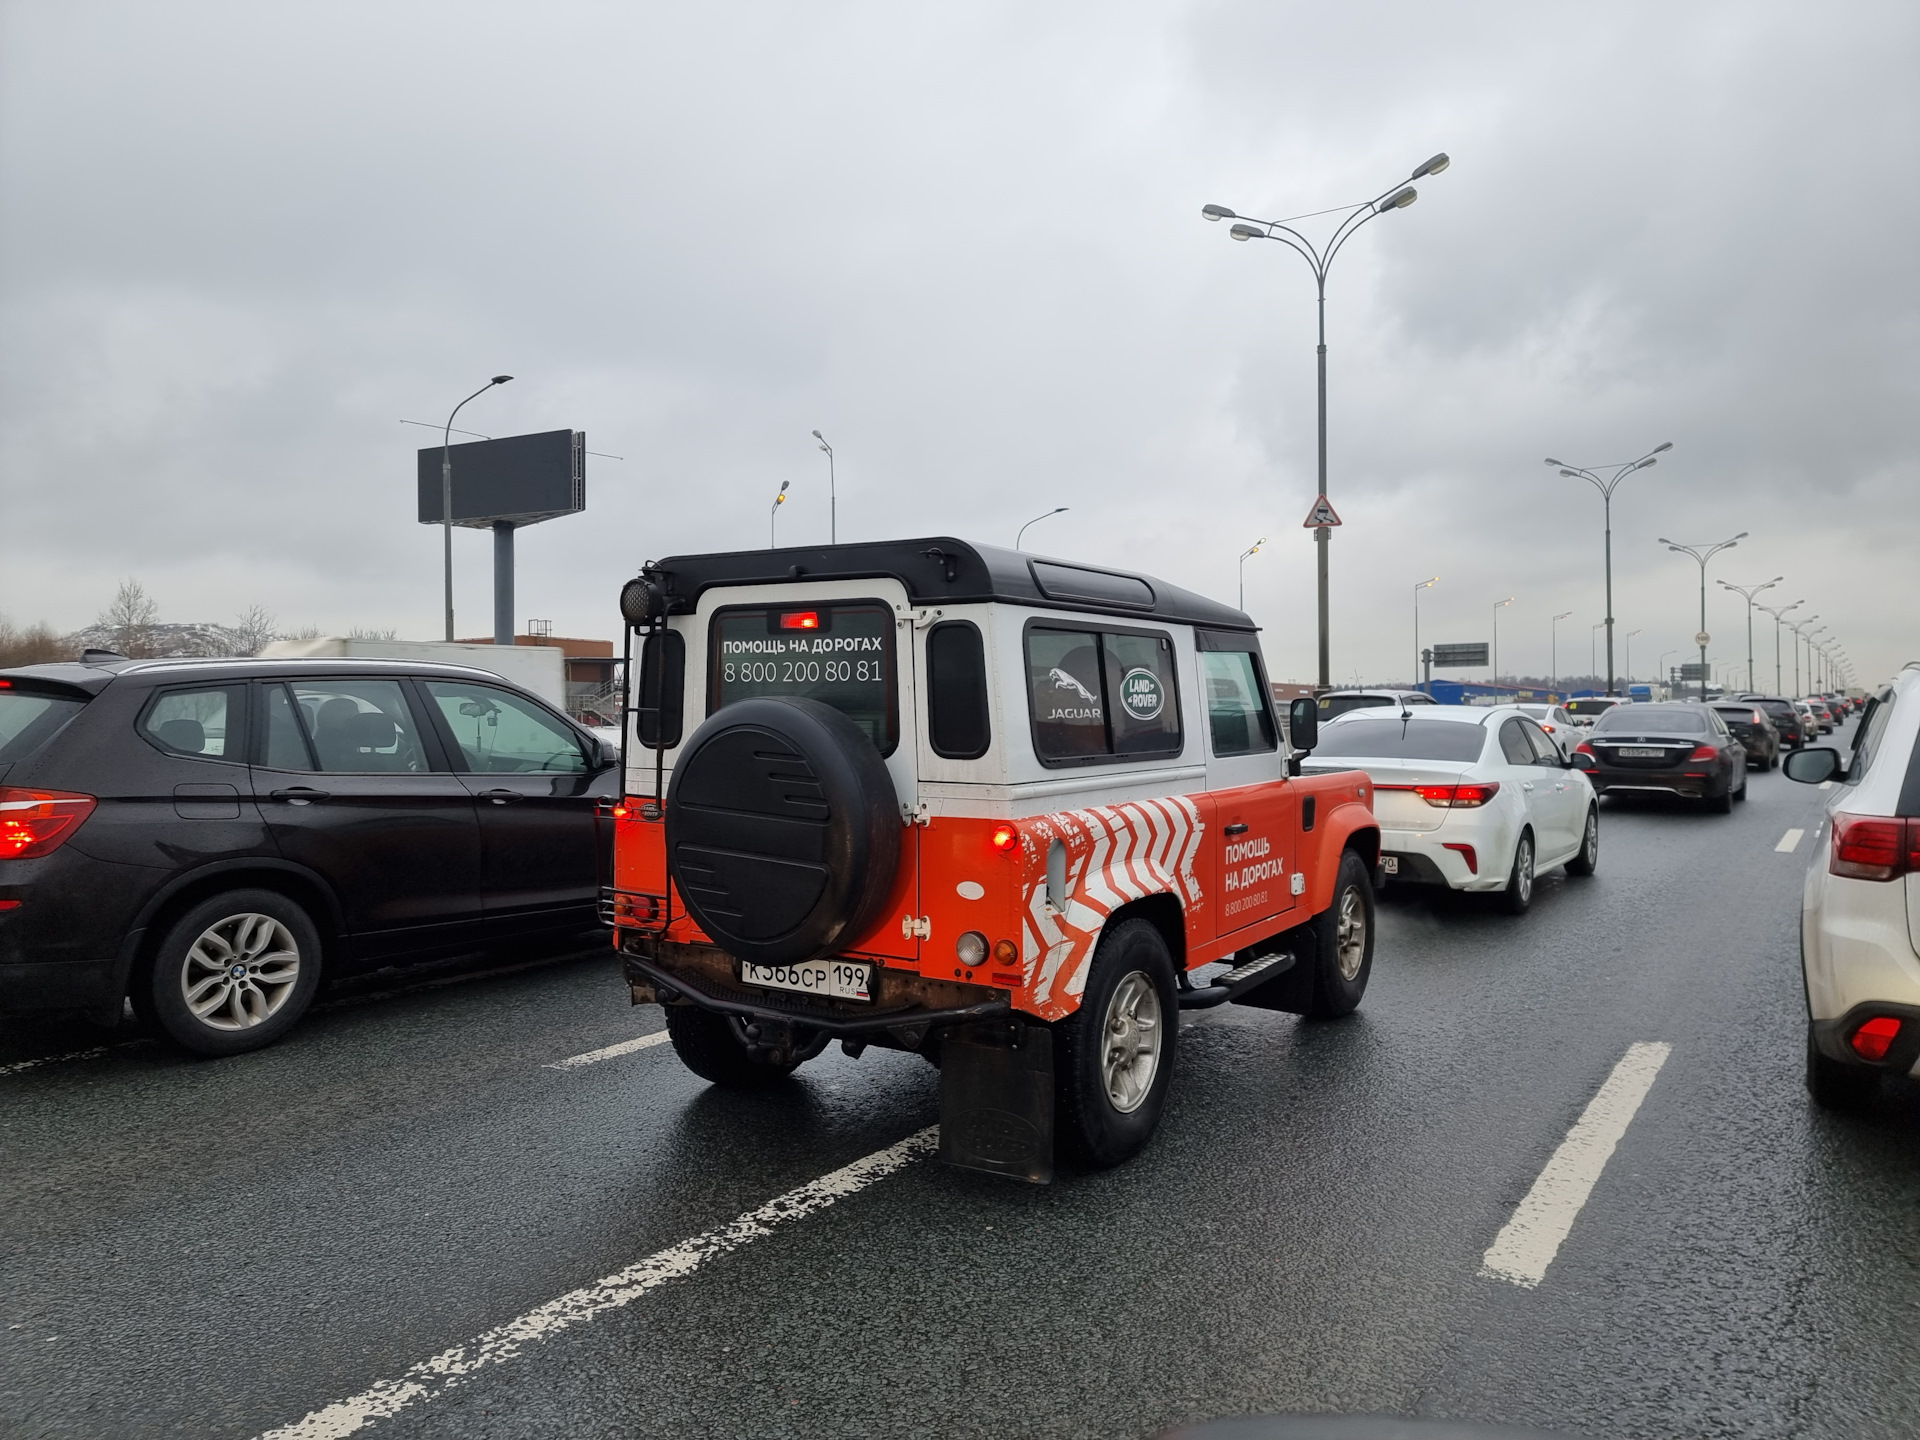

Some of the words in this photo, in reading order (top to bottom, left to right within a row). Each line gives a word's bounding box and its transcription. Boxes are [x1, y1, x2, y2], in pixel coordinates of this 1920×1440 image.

[723, 639, 786, 655] ПОМОЩЬ
[789, 639, 809, 653] НА
[811, 637, 882, 655] ДОРОГАХ
[724, 662, 736, 683] 8
[740, 662, 777, 683] 800
[782, 661, 820, 682] 200
[824, 660, 851, 682] 80
[856, 660, 883, 682] 81
[1129, 679, 1150, 693] LAND
[1132, 694, 1157, 708] ROVER
[1047, 708, 1101, 719] JAGUAR
[1226, 837, 1270, 865] ПОМОЩЬ
[1226, 871, 1239, 892] НА
[1241, 857, 1283, 890] ДОРОГАХ
[1225, 904, 1230, 916] 8
[1230, 900, 1241, 915] 800
[1242, 896, 1252, 910] 200
[1253, 893, 1260, 906] 80
[1261, 891, 1268, 903] 81
[833, 965, 865, 987] 199
[839, 986, 856, 995] RUS
